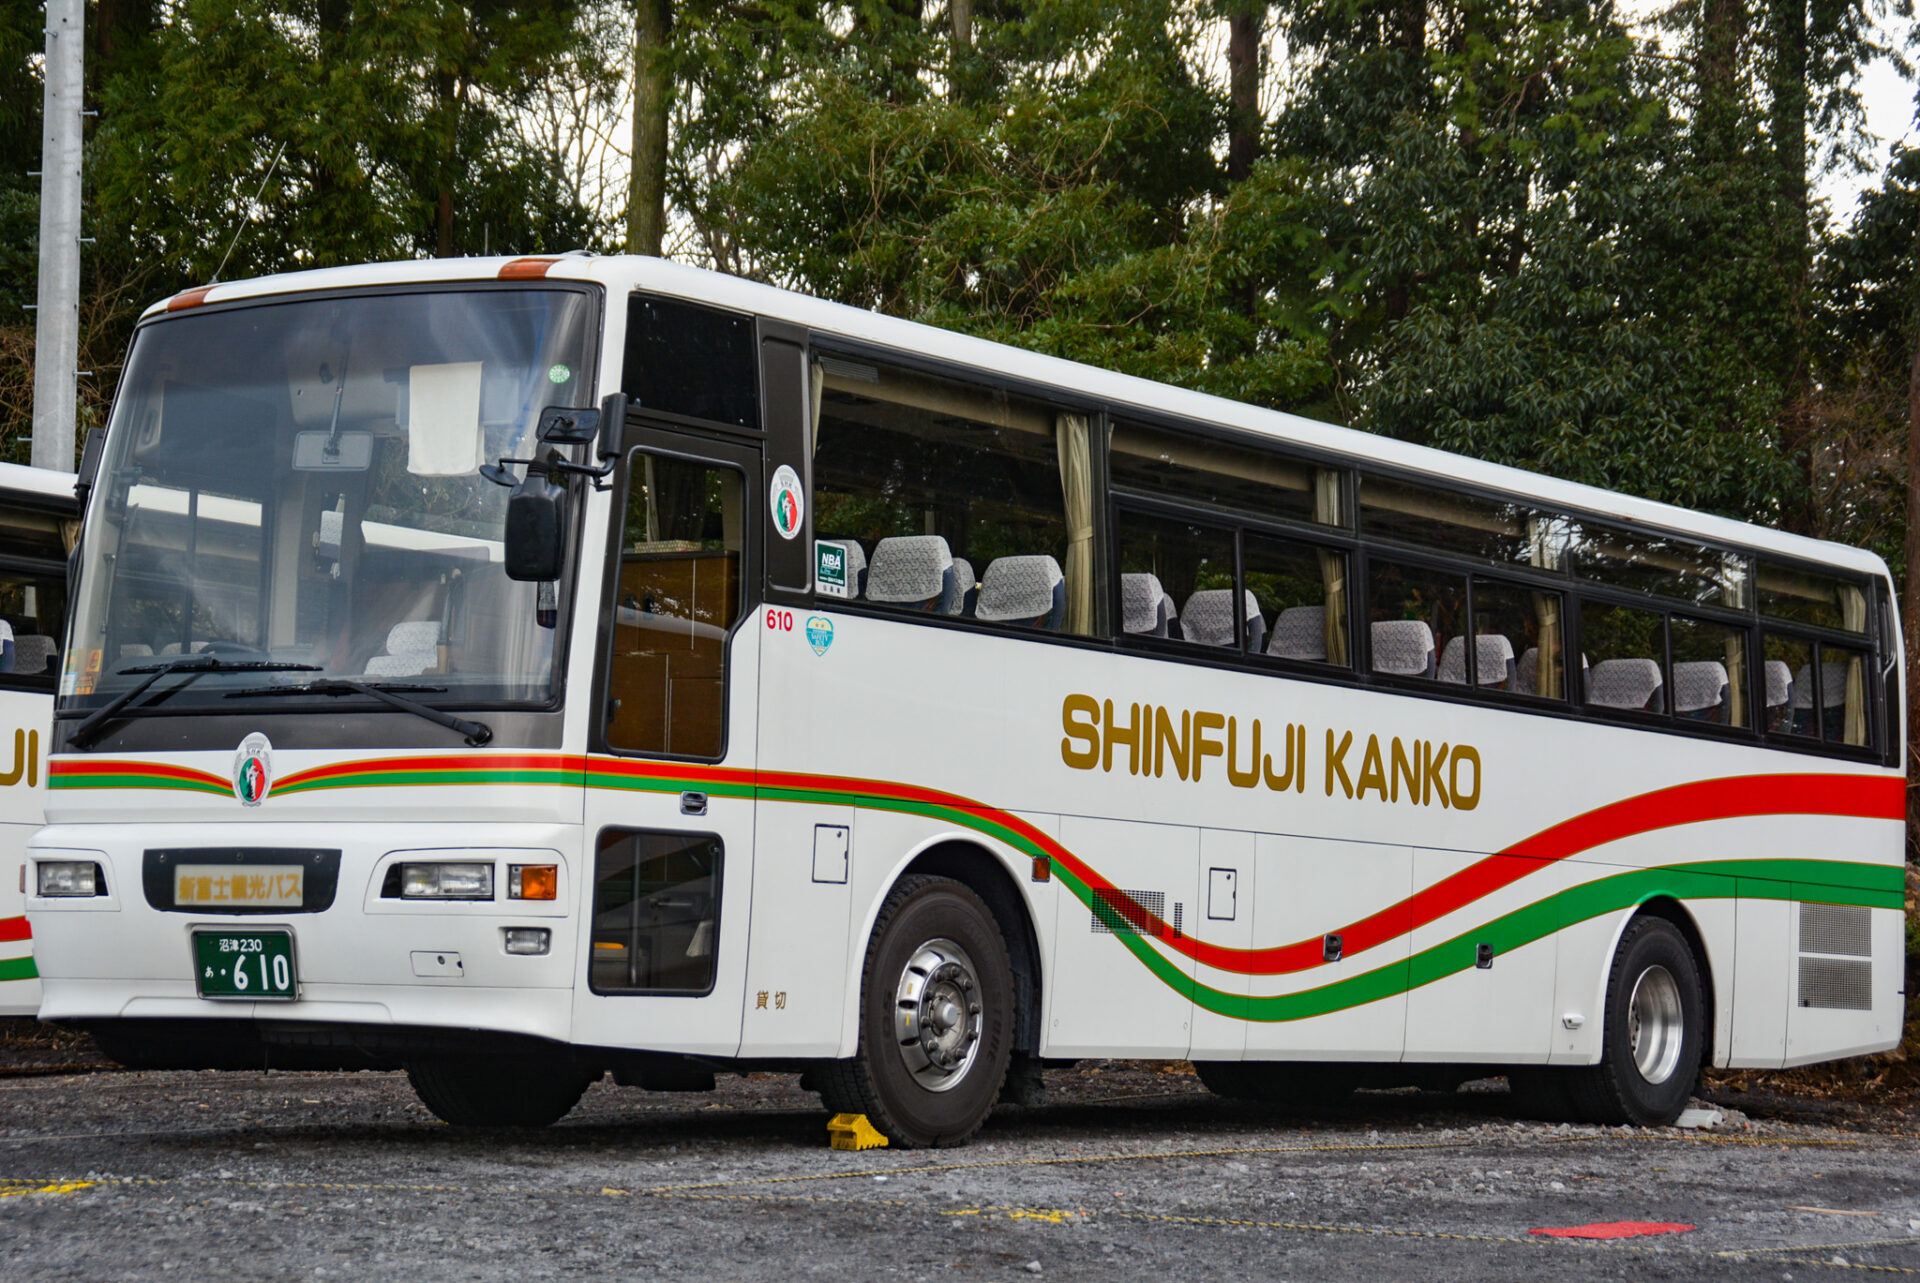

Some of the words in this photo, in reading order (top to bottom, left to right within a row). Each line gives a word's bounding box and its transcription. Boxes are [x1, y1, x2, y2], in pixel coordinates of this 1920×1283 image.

[821, 552, 841, 569] NBA
[766, 608, 793, 632] 610
[1061, 693, 1306, 794] SHINFUJI
[1325, 727, 1481, 811] KANKO
[179, 873, 302, 902] 新富士観光バス
[755, 990, 787, 1010] 貸切
